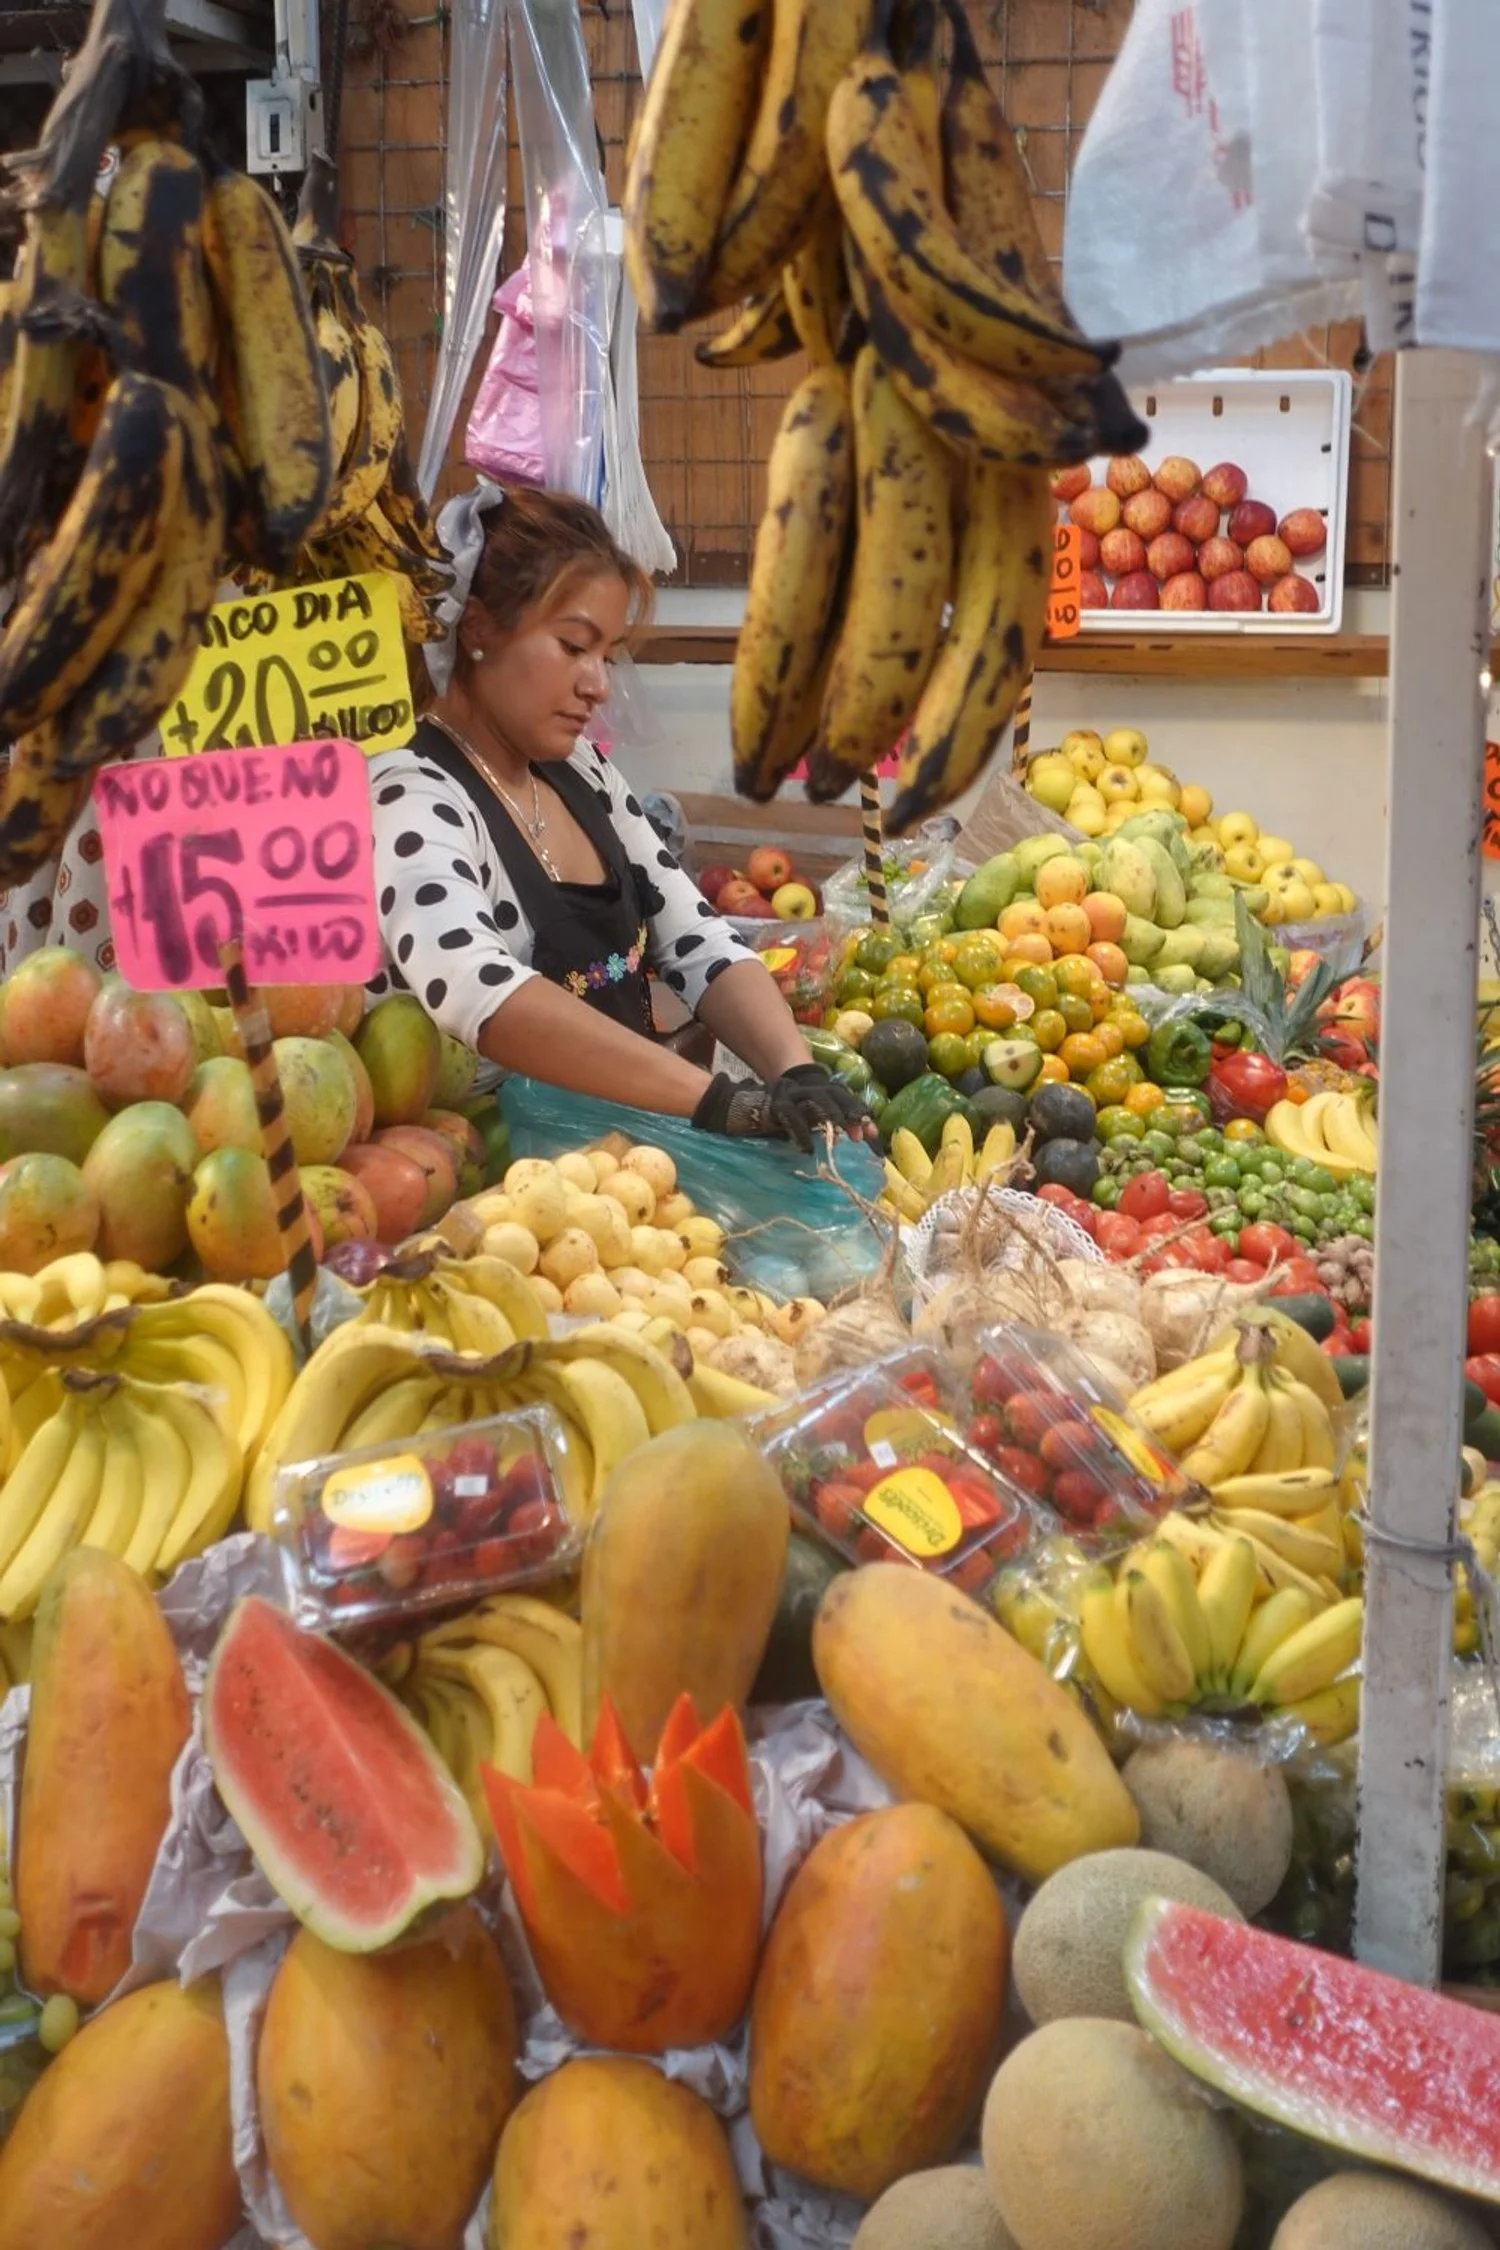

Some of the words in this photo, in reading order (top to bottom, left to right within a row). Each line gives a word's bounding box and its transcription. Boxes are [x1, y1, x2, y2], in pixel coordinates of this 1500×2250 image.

[293, 580, 373, 629] DIA
[101, 768, 170, 818] NO
[180, 744, 339, 810] BUENO
